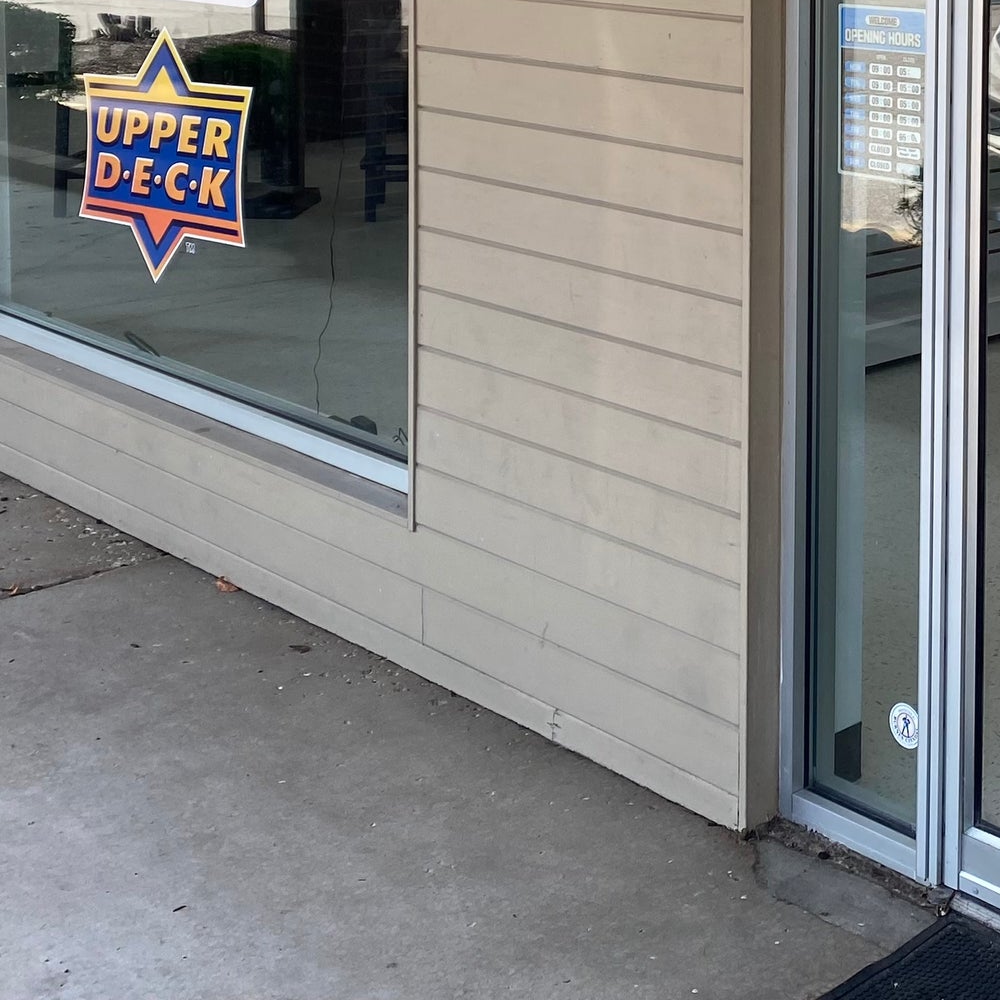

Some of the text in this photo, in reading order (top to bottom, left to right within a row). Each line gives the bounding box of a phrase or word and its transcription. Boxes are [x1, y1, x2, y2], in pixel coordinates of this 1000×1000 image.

[868, 16, 898, 26] WELCOME
[845, 28, 921, 48] OPENING HOURS
[96, 106, 232, 158] UPPER
[870, 144, 890, 155] CLOSED
[869, 160, 890, 170] CLOSED
